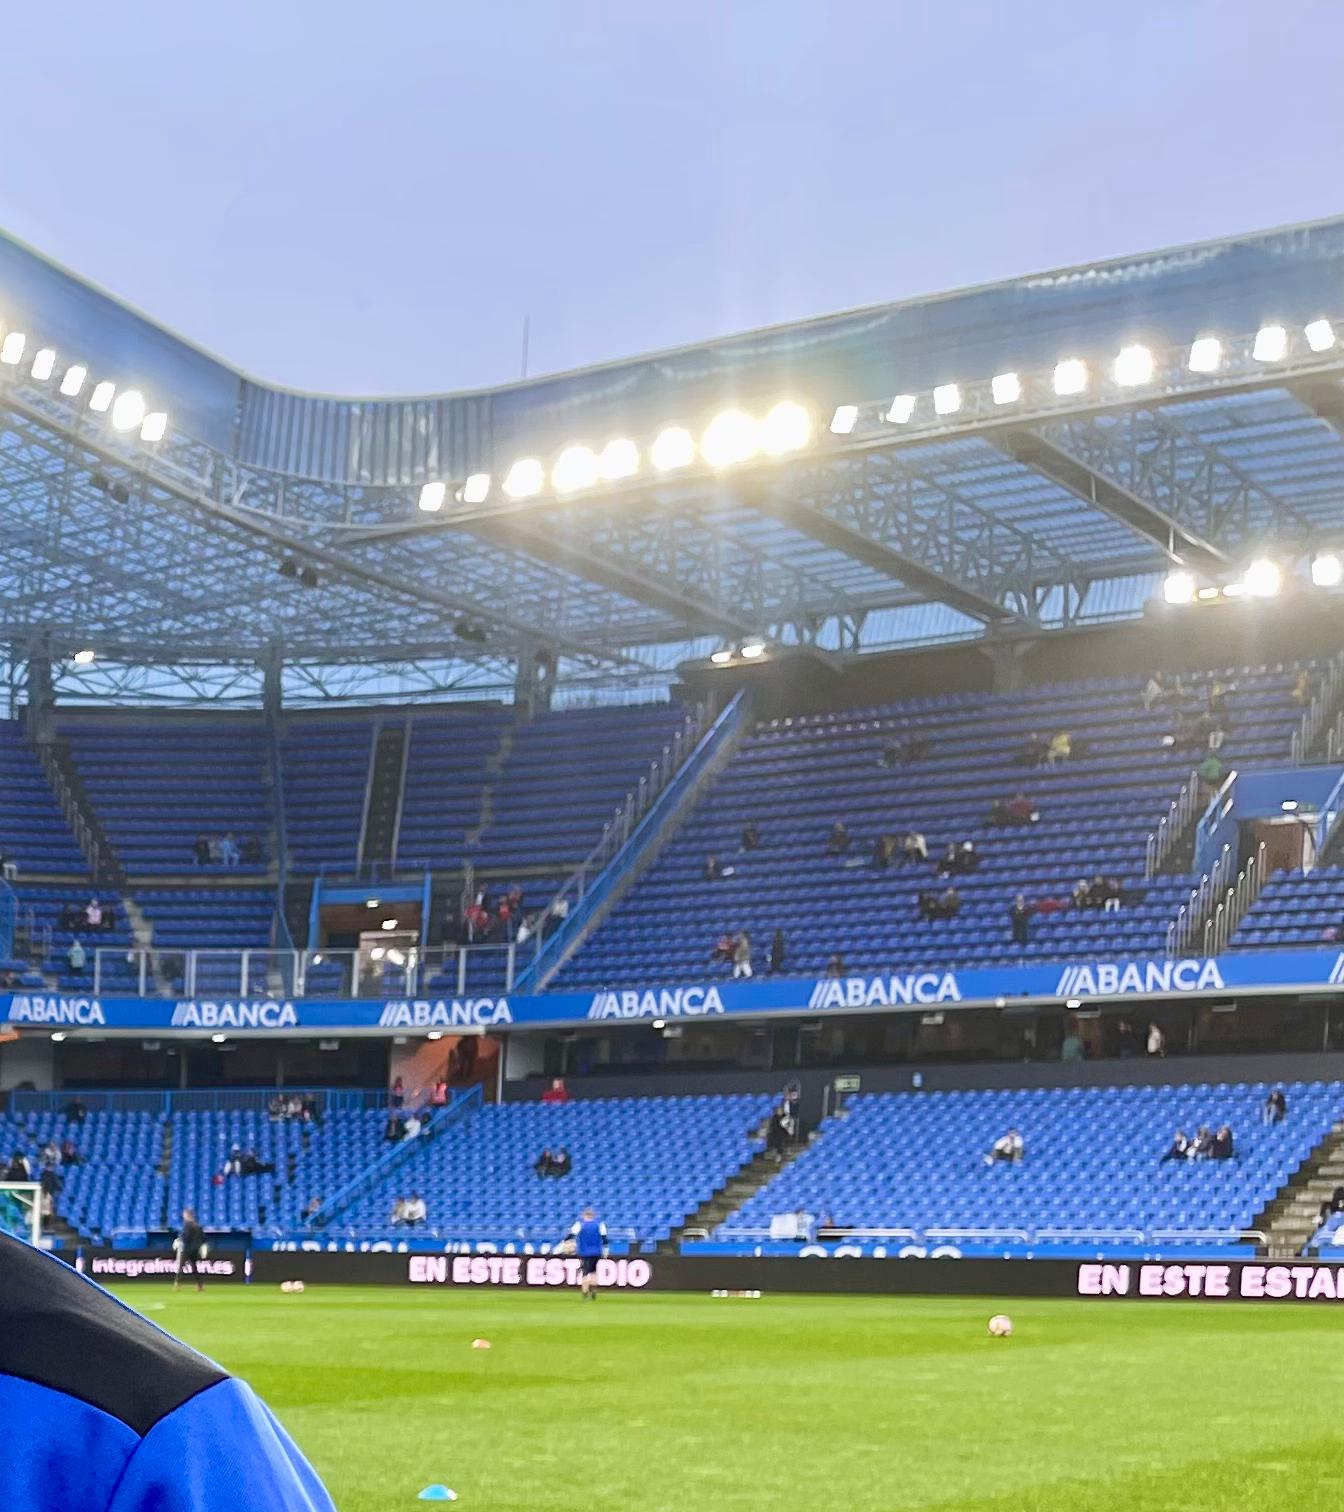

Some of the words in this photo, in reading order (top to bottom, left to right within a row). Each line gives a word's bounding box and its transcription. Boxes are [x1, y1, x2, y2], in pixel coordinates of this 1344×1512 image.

[408, 1255, 448, 1283] EN
[452, 1256, 522, 1284] ESTE
[526, 1258, 652, 1287] ESTDIO
[1077, 1264, 1130, 1295] EN
[1139, 1265, 1231, 1297] ESTE
[1240, 1265, 1344, 1299] ESTA
